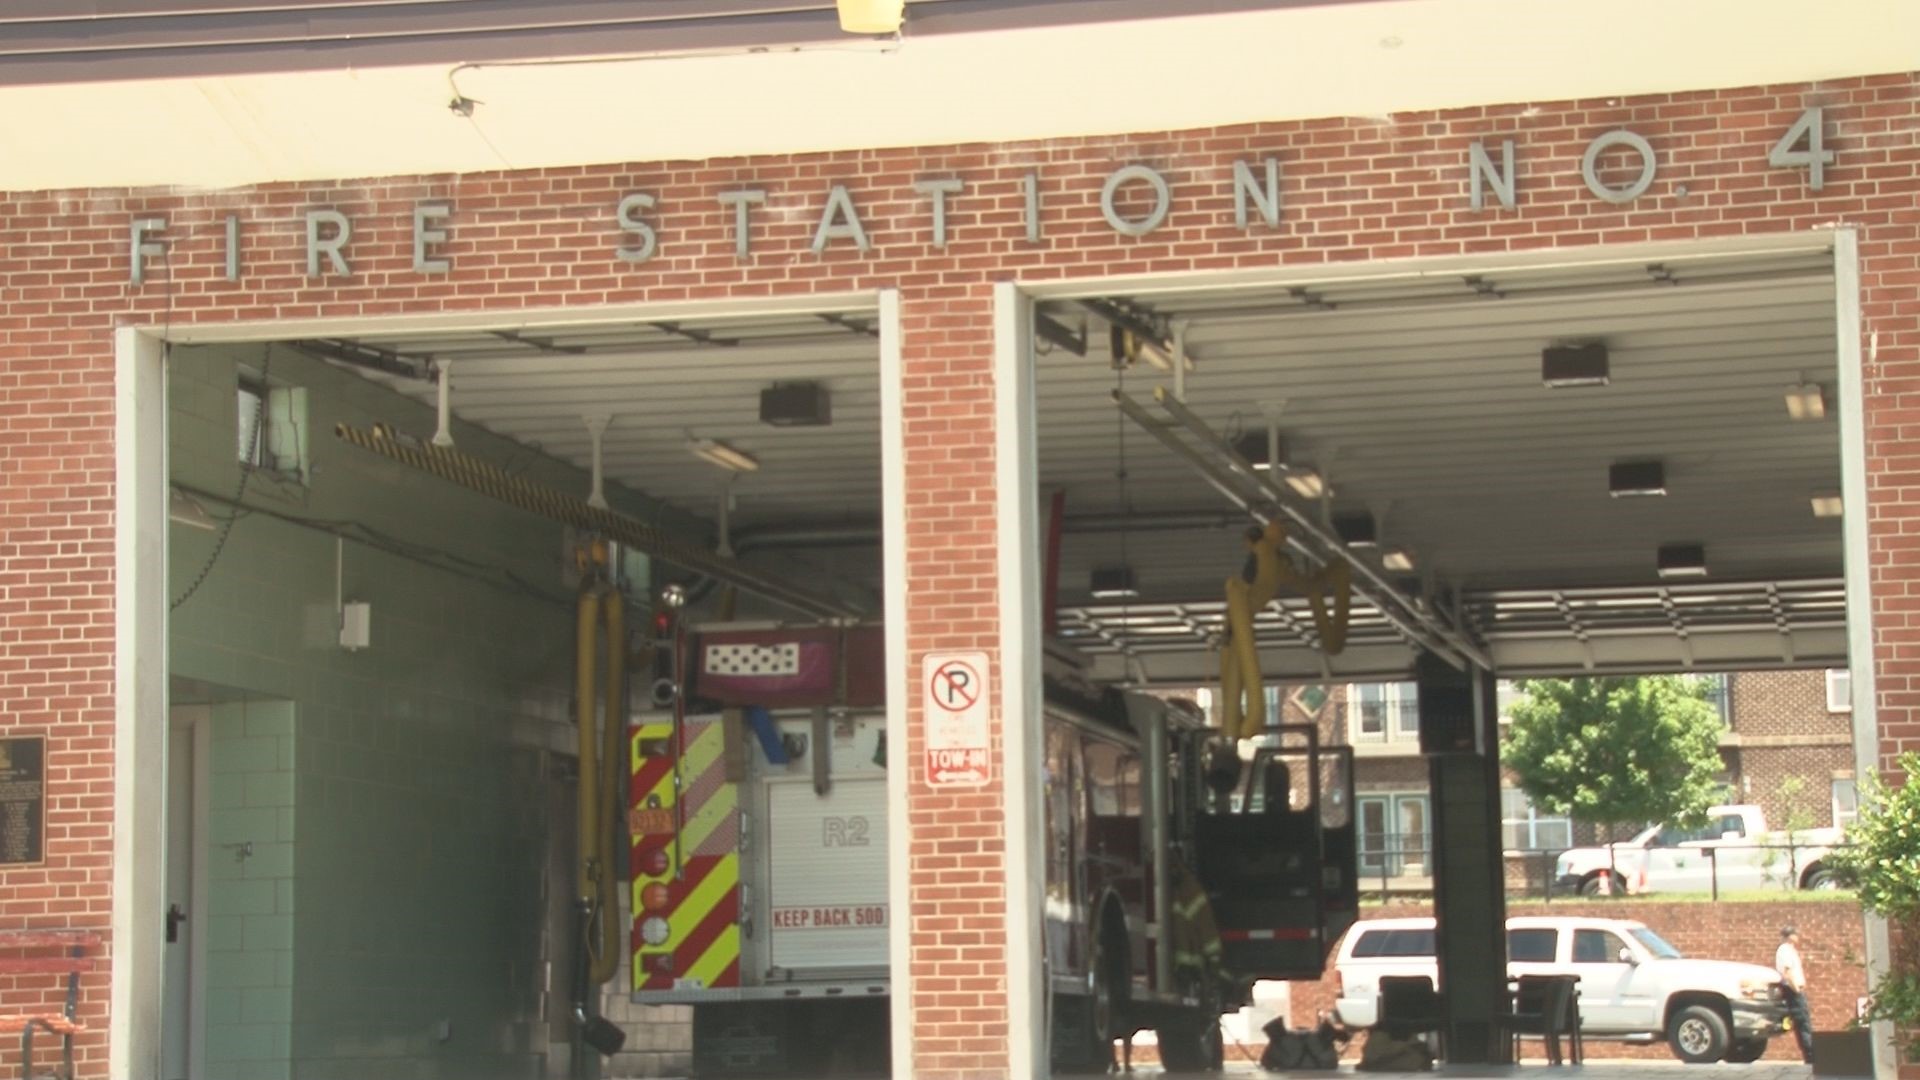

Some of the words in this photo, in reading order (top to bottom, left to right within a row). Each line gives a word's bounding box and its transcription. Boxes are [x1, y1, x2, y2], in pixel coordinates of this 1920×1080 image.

[130, 203, 453, 286] FIRE
[615, 157, 1280, 264] STATION
[1768, 107, 1835, 192] 4
[823, 815, 870, 847] R2
[773, 909, 809, 928] KEEP
[813, 907, 851, 926] BACK
[855, 906, 884, 925] 500
